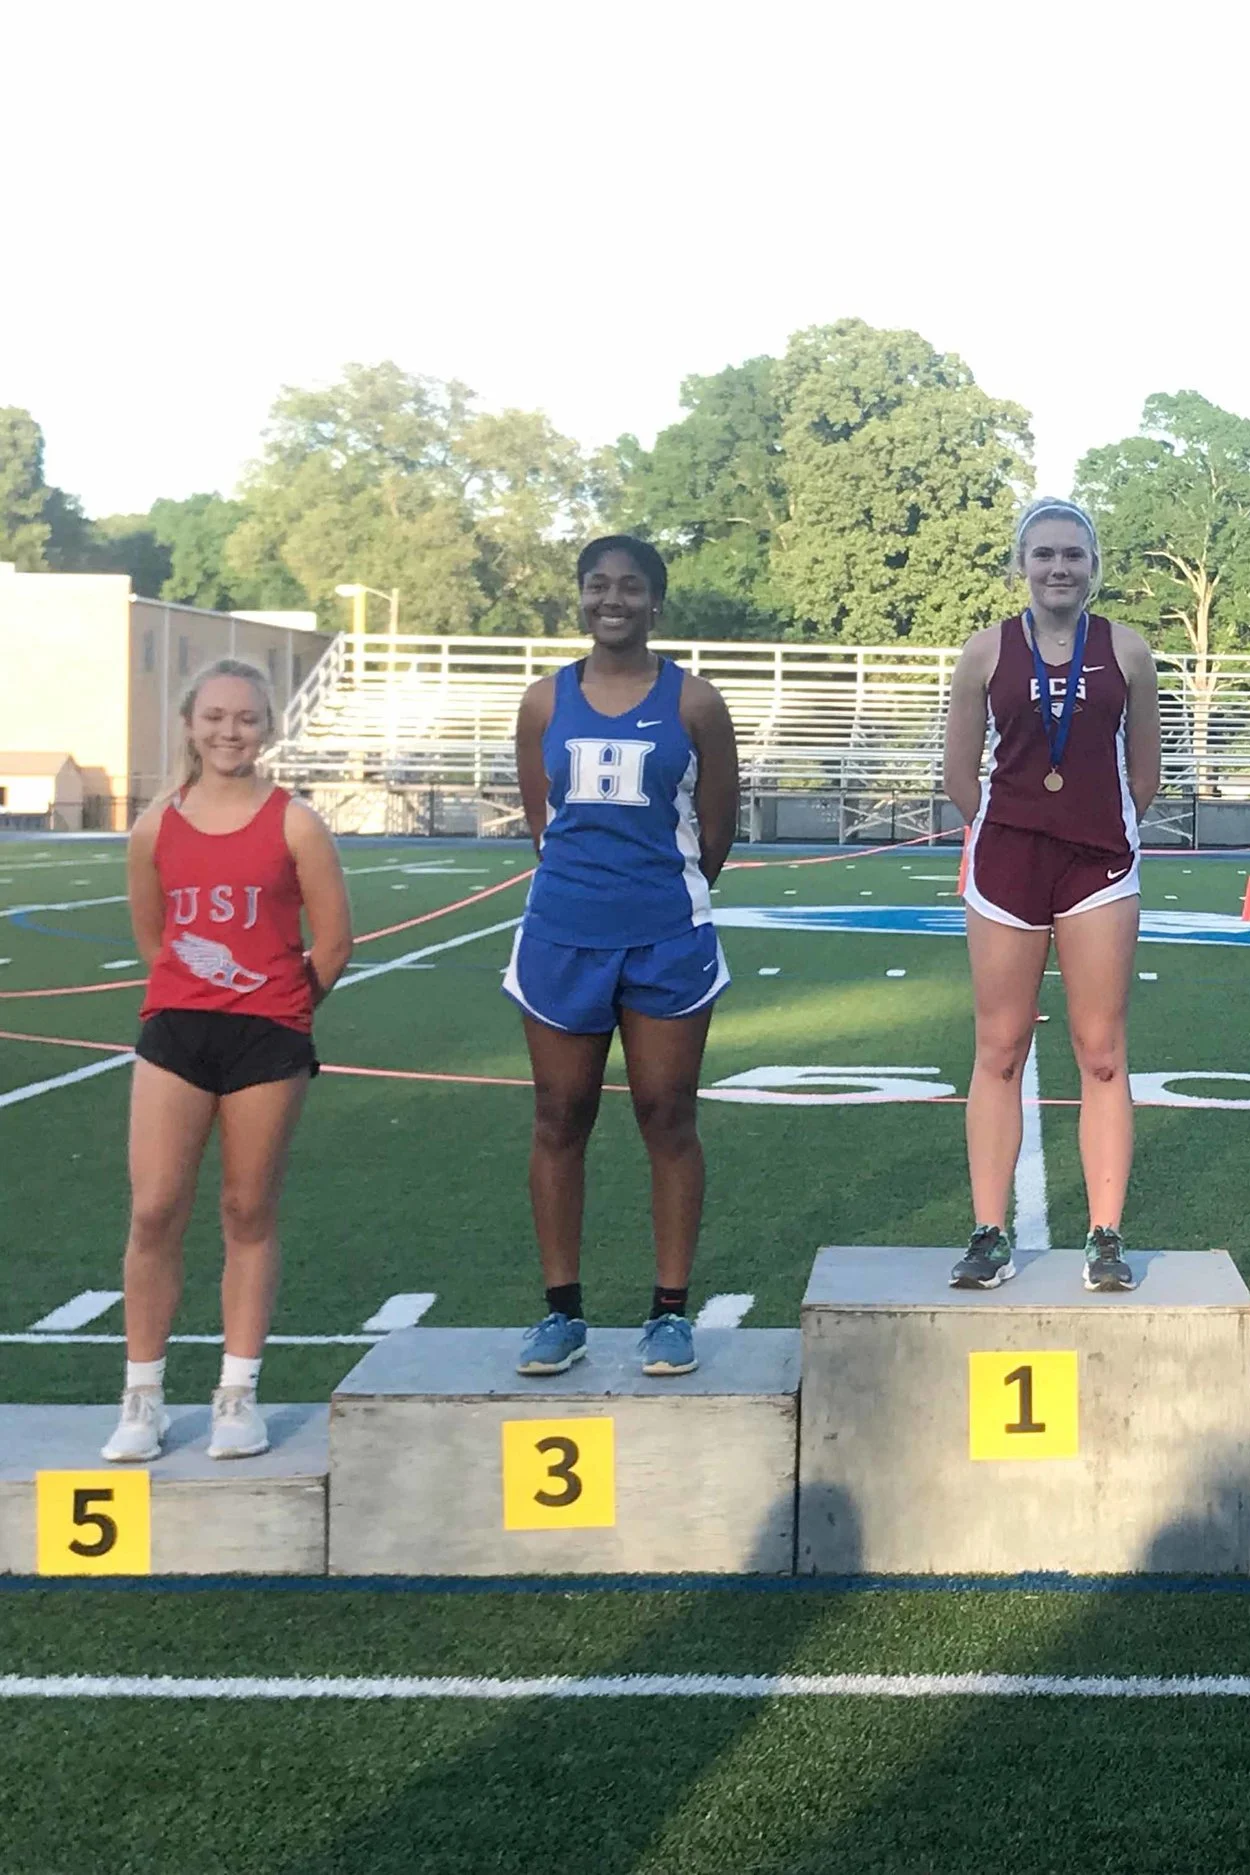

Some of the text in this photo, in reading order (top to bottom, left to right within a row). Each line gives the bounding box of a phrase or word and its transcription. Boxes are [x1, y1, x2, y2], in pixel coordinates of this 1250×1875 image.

[564, 737, 656, 807] H
[168, 884, 262, 929] USJ
[1004, 1366, 1045, 1432] 1
[533, 1437, 581, 1506] 3
[67, 1489, 116, 1556] 5
